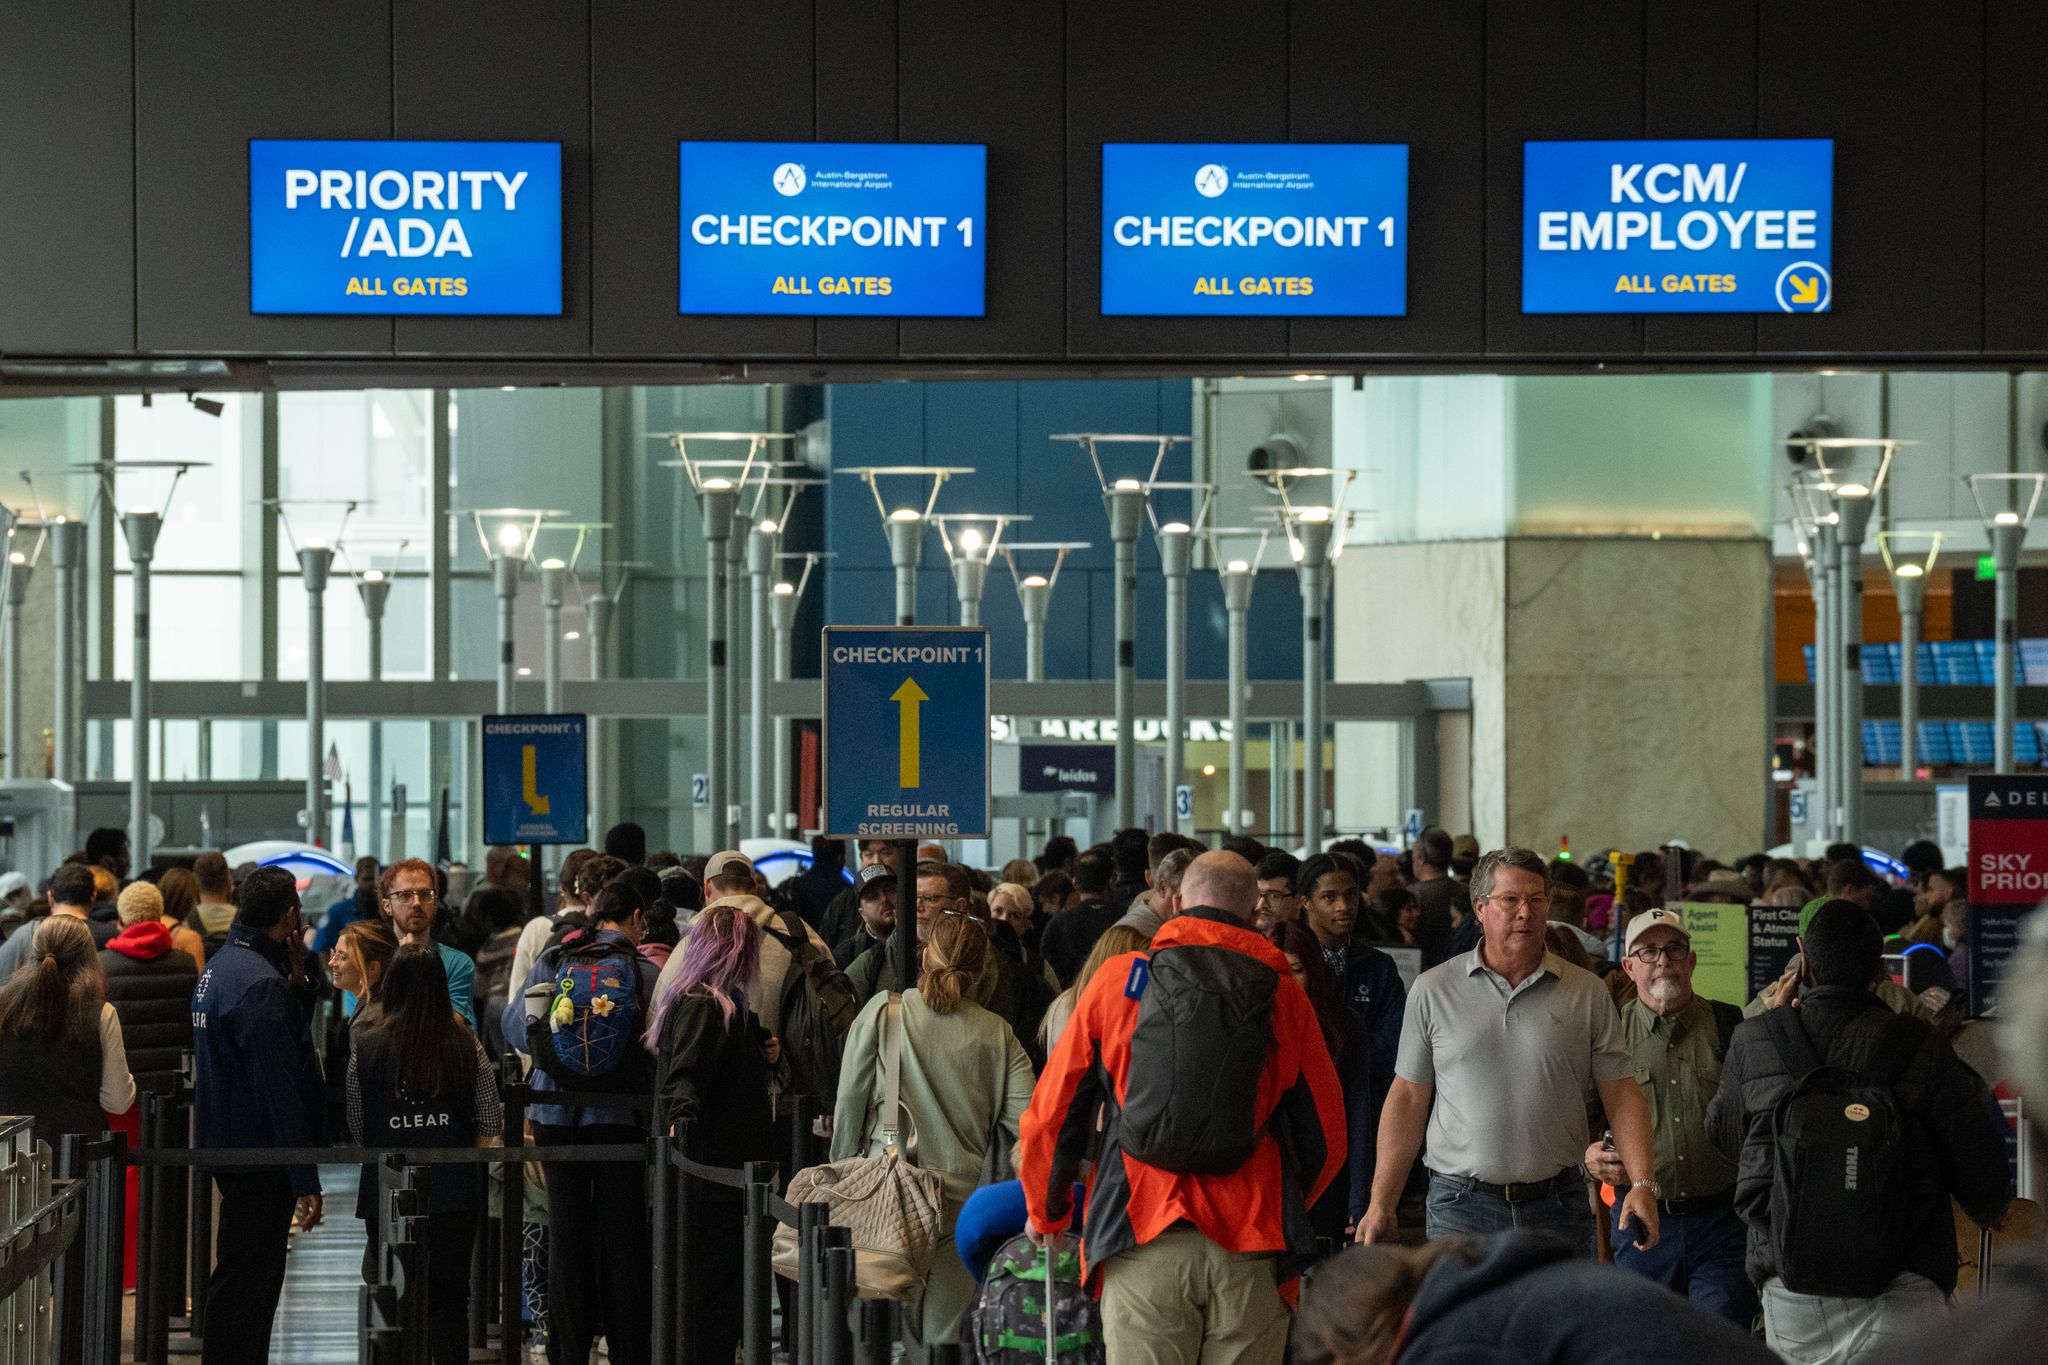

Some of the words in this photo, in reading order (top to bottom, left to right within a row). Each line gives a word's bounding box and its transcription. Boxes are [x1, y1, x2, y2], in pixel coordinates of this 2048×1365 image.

[815, 171, 888, 180] Austin-Bergstrom
[1610, 162, 1747, 203] KCM/
[286, 169, 529, 211] PRIORITY
[811, 180, 861, 189] International
[864, 181, 892, 190] Airport
[340, 216, 473, 258] /ADA
[691, 214, 947, 247] CHECKPOINT
[956, 216, 973, 247] 1
[1113, 215, 1368, 247] CHECKPOINT
[1377, 216, 1394, 247] 1
[1538, 210, 1817, 250] EMPLOYEE
[345, 276, 387, 296] ALL
[392, 276, 468, 297] GATES
[771, 276, 812, 295] ALL
[818, 276, 892, 296] GATES
[1193, 277, 1234, 295] ALL
[1239, 277, 1313, 296] GATES
[1614, 274, 1656, 293] ALL
[1661, 274, 1737, 293] GATES
[833, 647, 970, 663] CHECKPOINT
[975, 648, 983, 663] 1
[486, 724, 570, 735] CHECKPOINT
[574, 723, 580, 734] 1
[1058, 768, 1097, 782] leidos
[867, 804, 950, 817] REGULAR
[858, 822, 959, 835] SCREENING
[1981, 854, 2032, 871] SKY
[1688, 910, 1718, 921] Agent
[1752, 909, 1777, 920] First
[1688, 922, 1717, 932] Assist
[1752, 923, 1761, 934] &
[1753, 936, 1788, 947] Status
[389, 1113, 449, 1129] CLEAR
[1845, 1146, 1858, 1190] THULE
